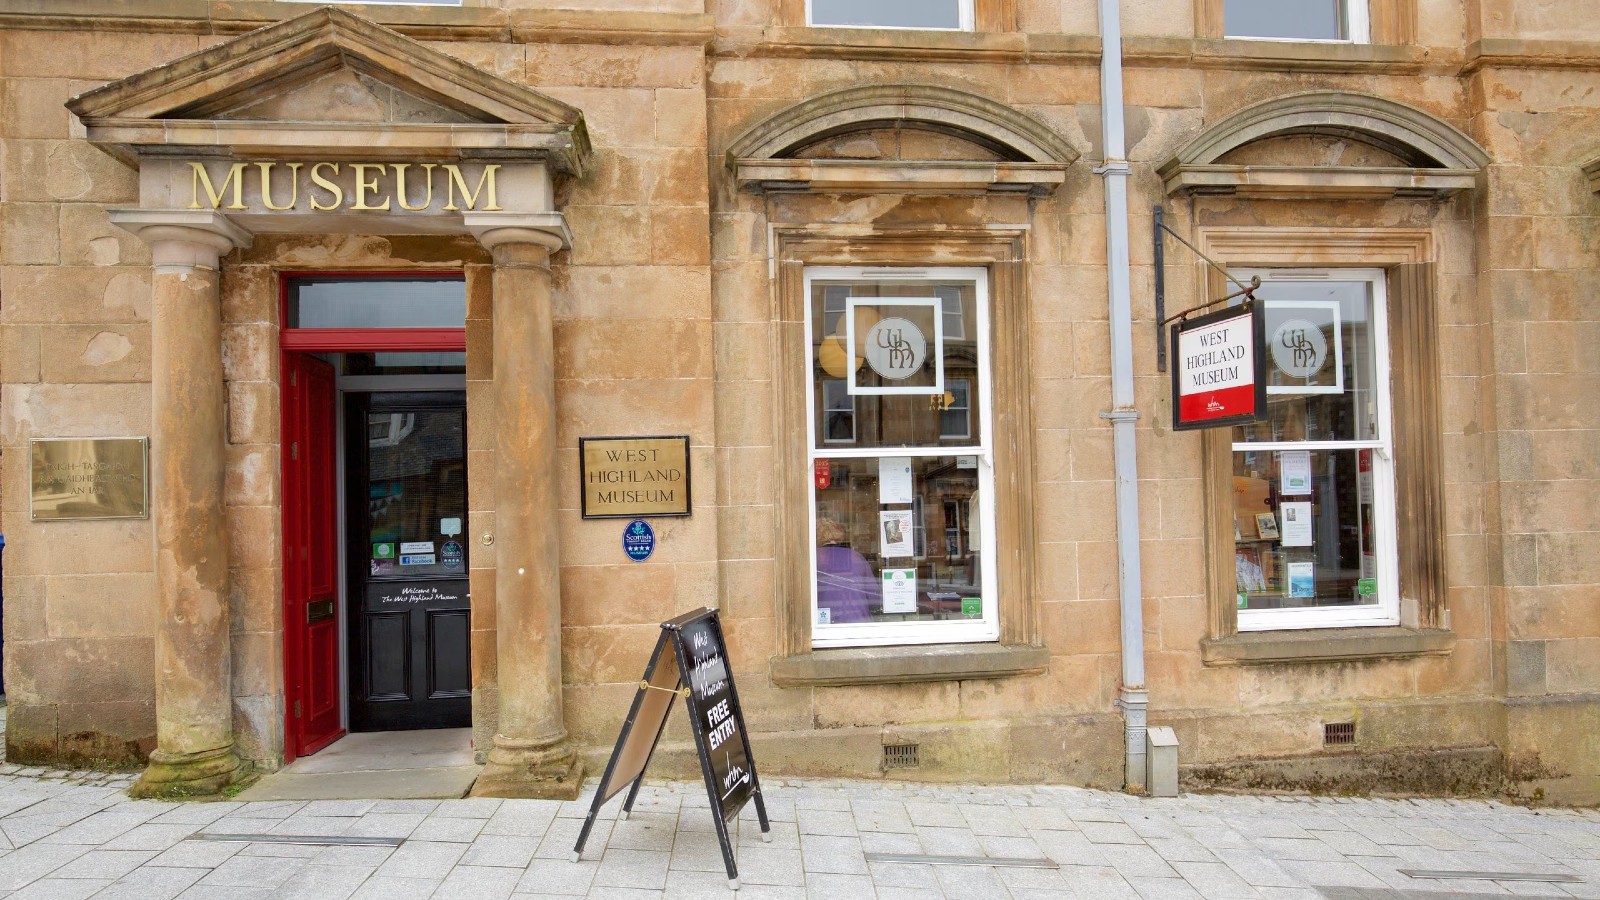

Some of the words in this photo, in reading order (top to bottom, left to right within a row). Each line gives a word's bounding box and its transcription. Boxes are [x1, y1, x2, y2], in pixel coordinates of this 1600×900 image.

[186, 161, 503, 211] MUSEUM
[1199, 328, 1229, 348] WEST
[1187, 345, 1245, 370] HIGHLAND
[1192, 366, 1239, 387] MUSEUM
[606, 448, 660, 462] WEST
[590, 468, 681, 483] HIGHLAND
[598, 489, 674, 504] MUSEUM
[381, 595, 392, 603] The
[408, 594, 434, 604] Highland
[401, 587, 430, 595] Welcome
[700, 680, 725, 701] Museum
[706, 698, 730, 729] FREE
[708, 714, 736, 751] ENTRY
